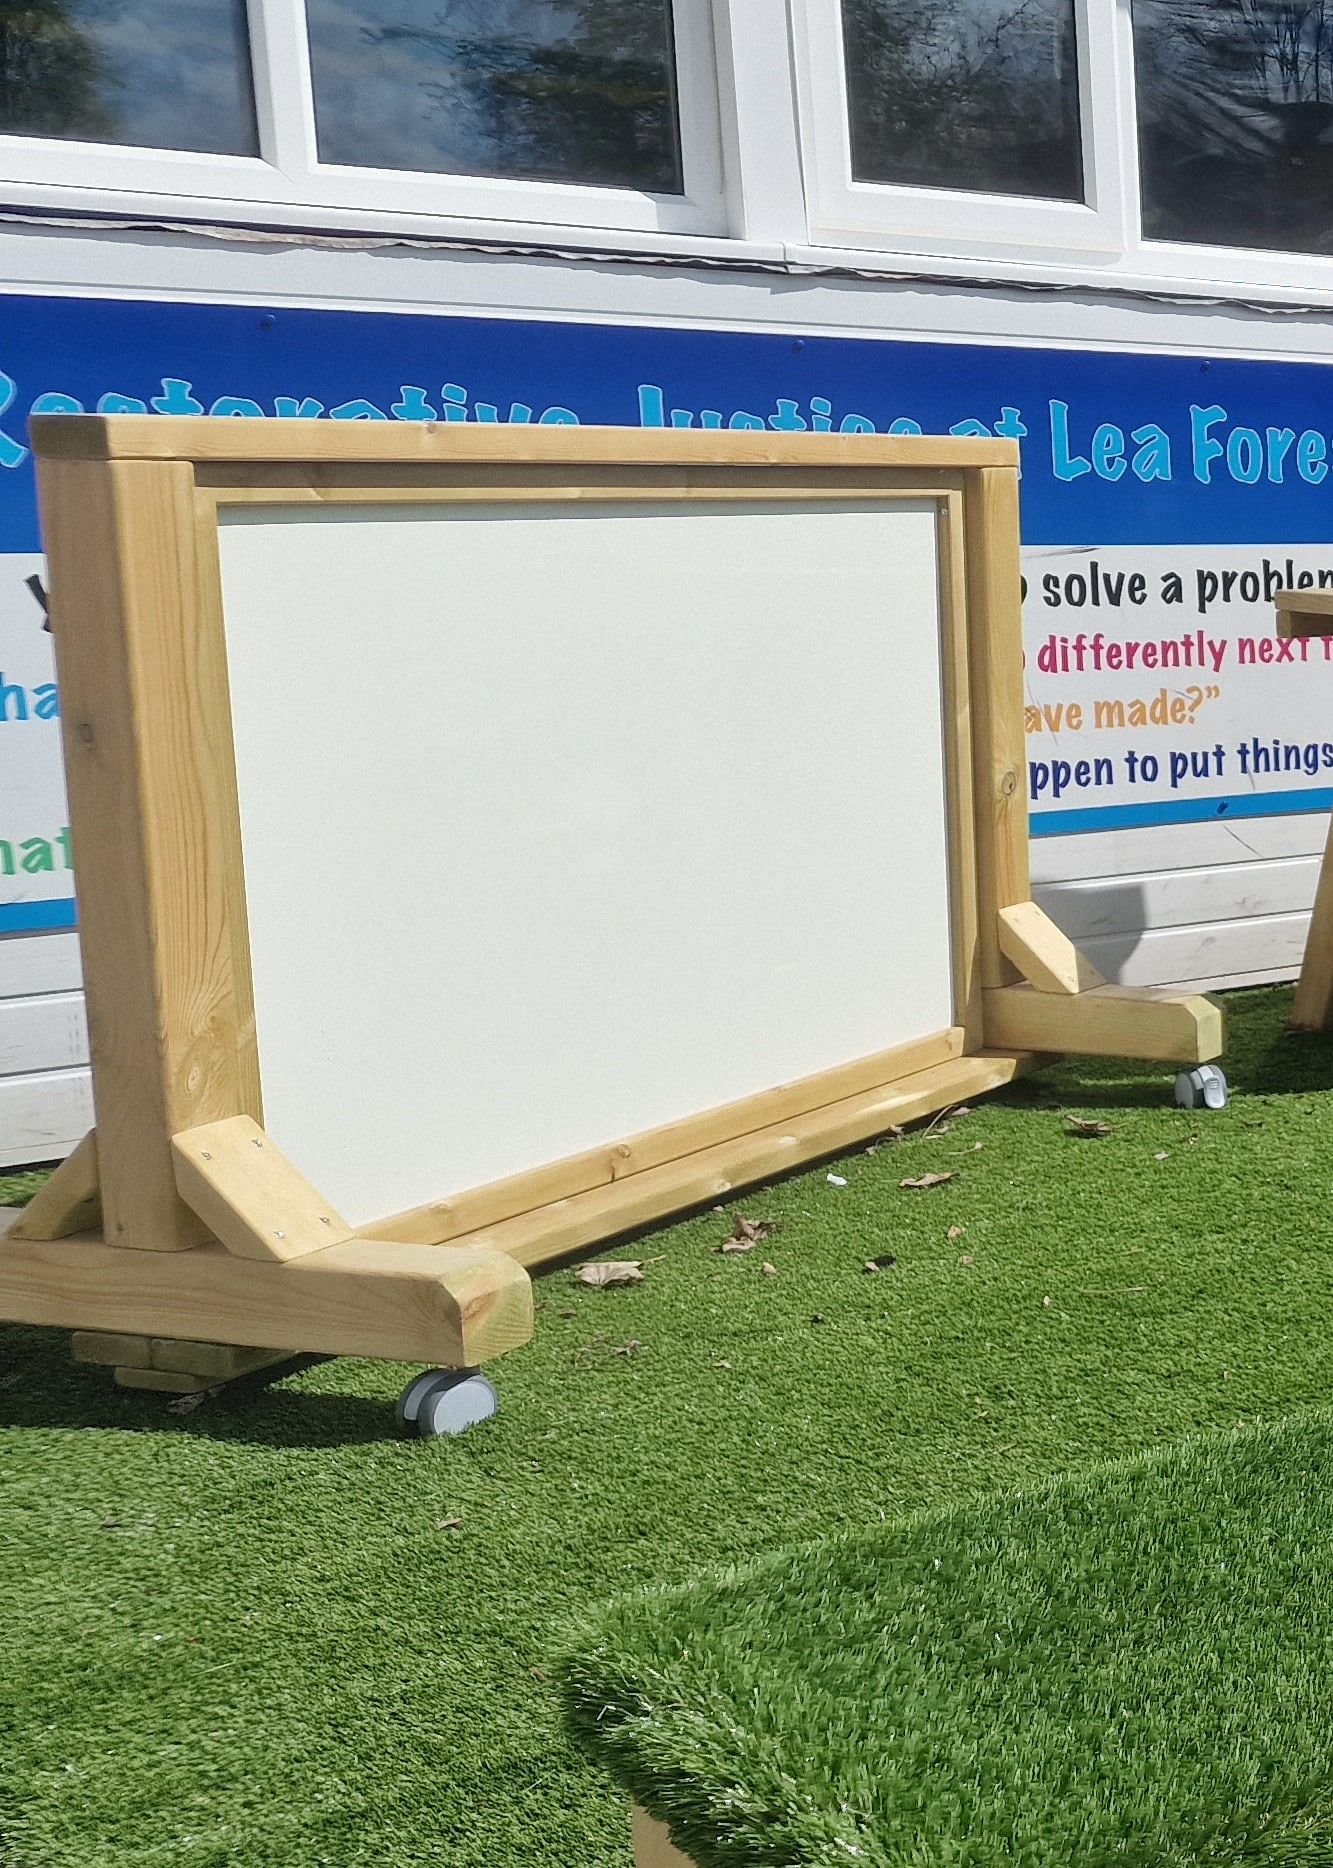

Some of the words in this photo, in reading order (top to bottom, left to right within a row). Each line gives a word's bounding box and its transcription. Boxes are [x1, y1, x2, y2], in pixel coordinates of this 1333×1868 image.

[1049, 399, 1172, 482] Lea
[1043, 561, 1147, 608] solve
[1160, 571, 1184, 604] a
[1037, 630, 1228, 674] differently
[1124, 750, 1159, 784] to
[1170, 744, 1227, 788] put
